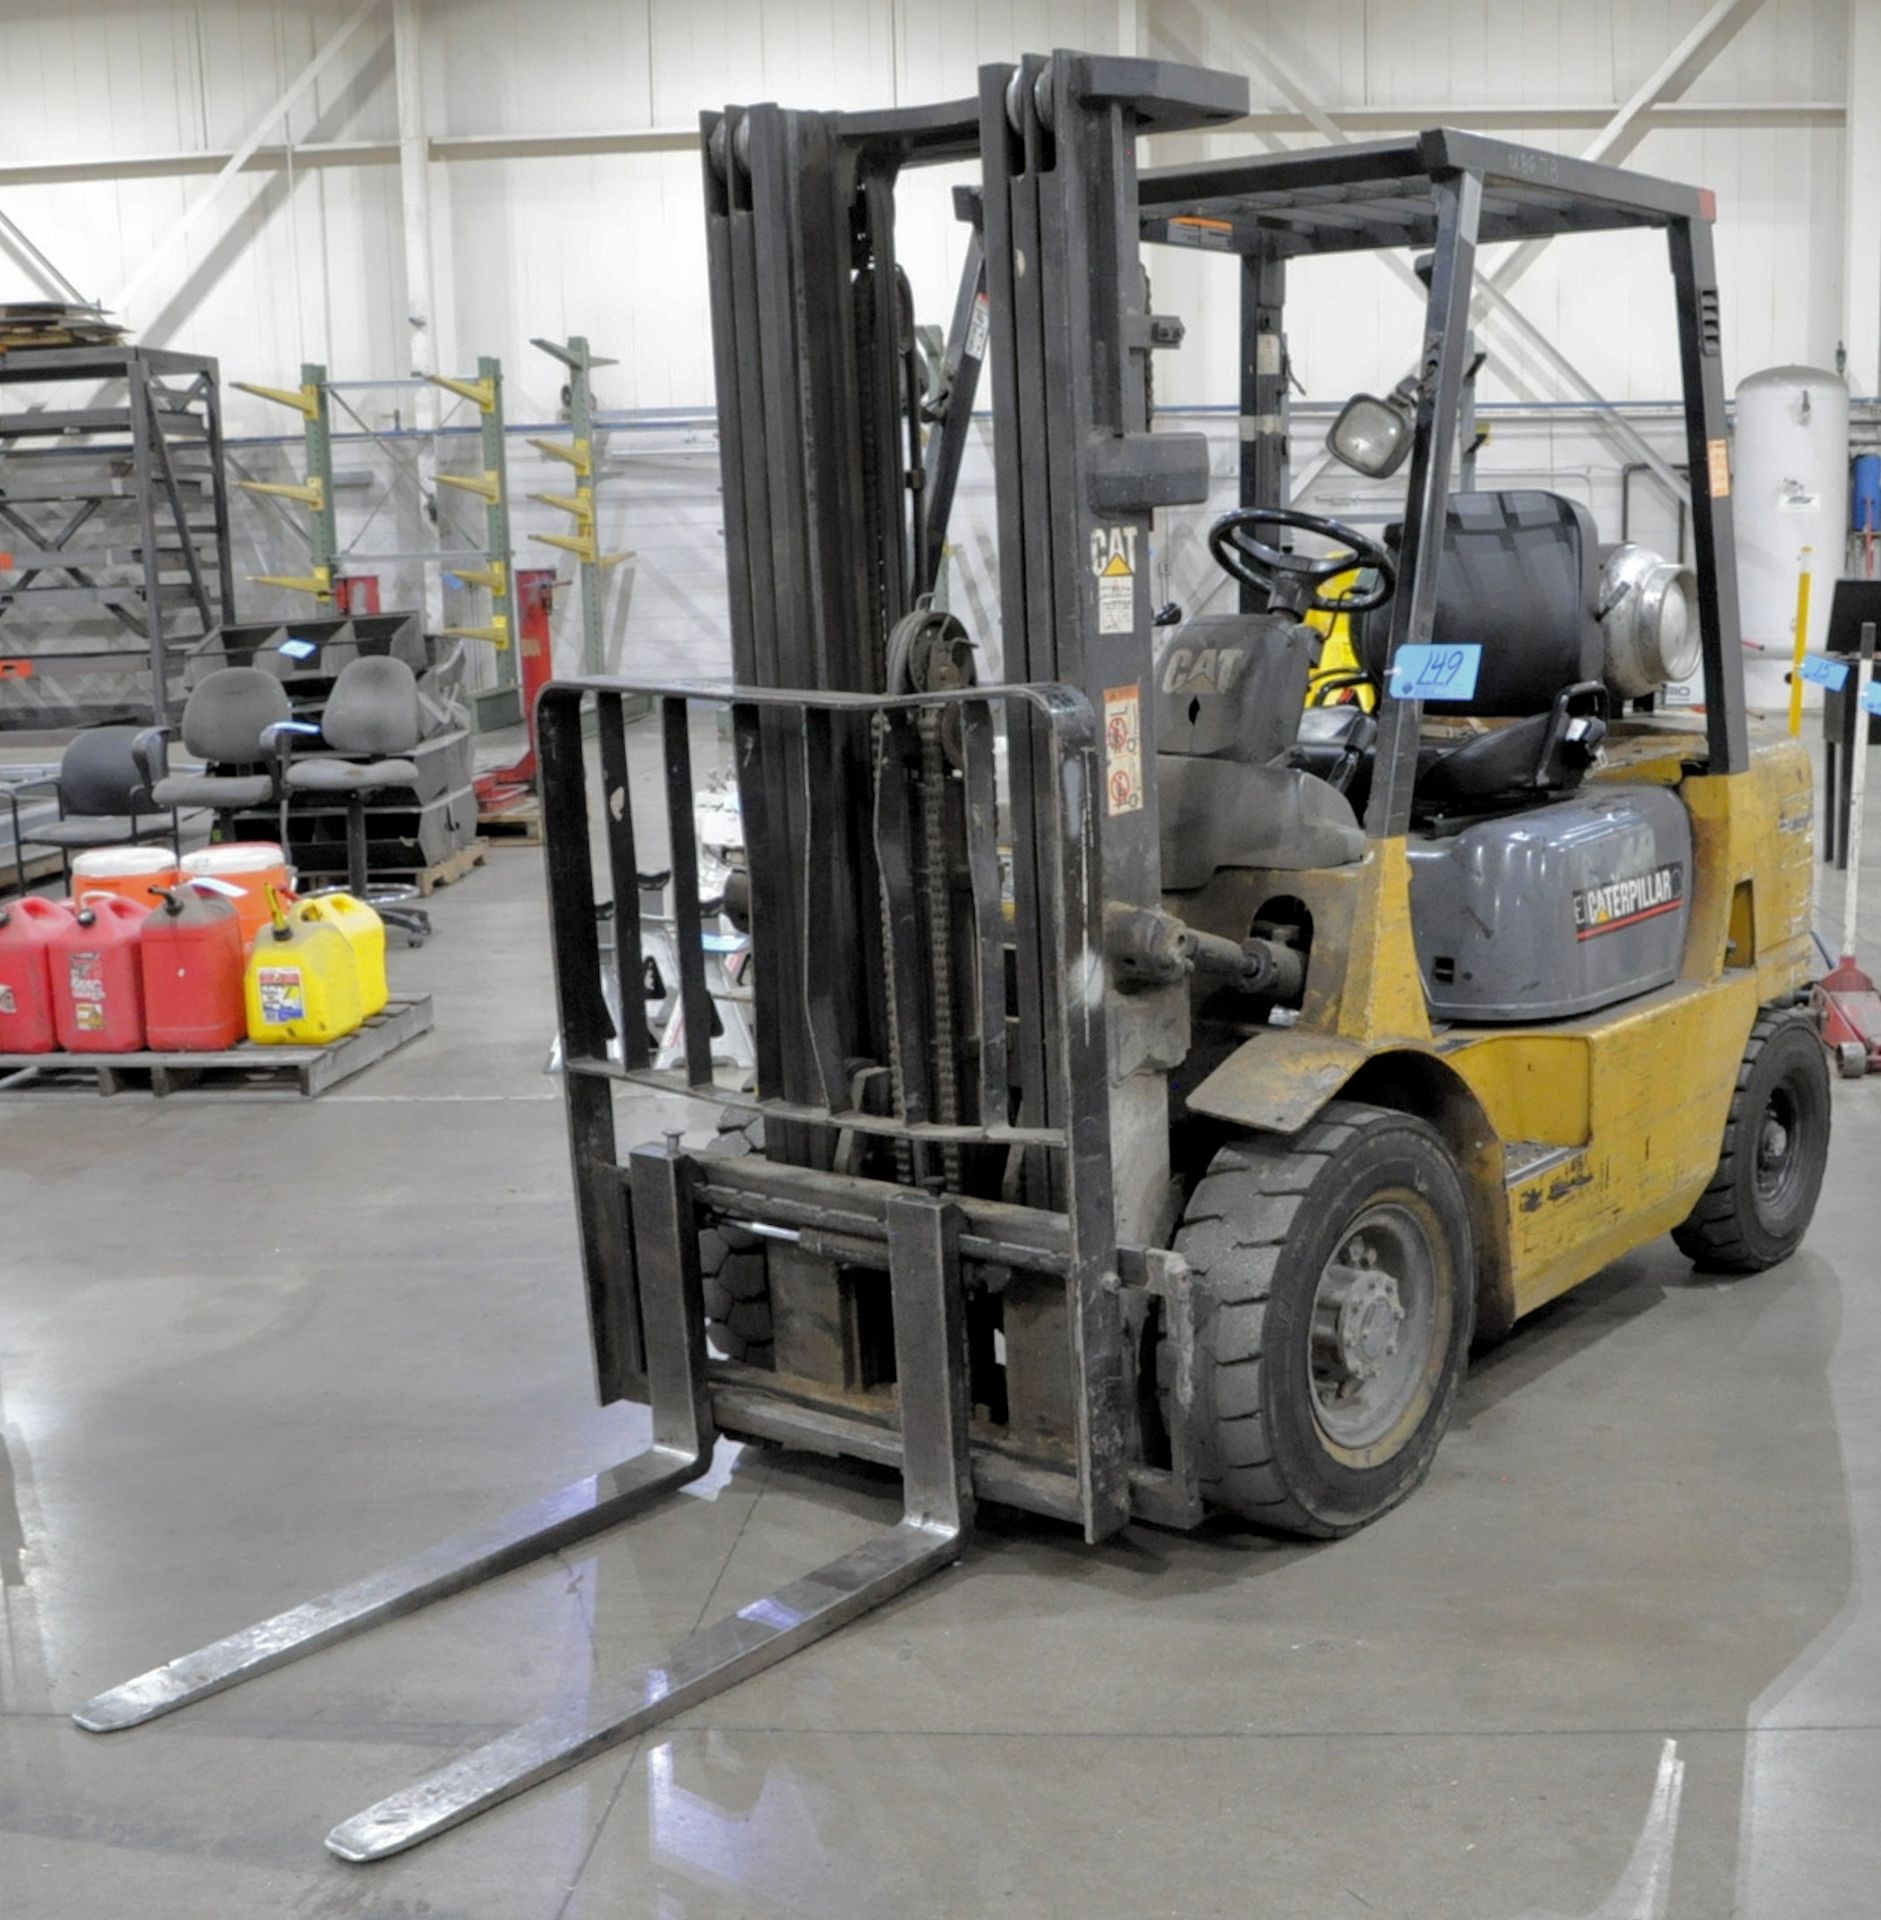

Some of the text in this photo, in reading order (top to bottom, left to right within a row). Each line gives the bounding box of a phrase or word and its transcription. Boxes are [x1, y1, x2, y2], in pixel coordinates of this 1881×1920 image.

[1091, 526, 1138, 577] CAT
[1161, 647, 1245, 695] CAT
[1587, 869, 1673, 925] CATERPILLAR
